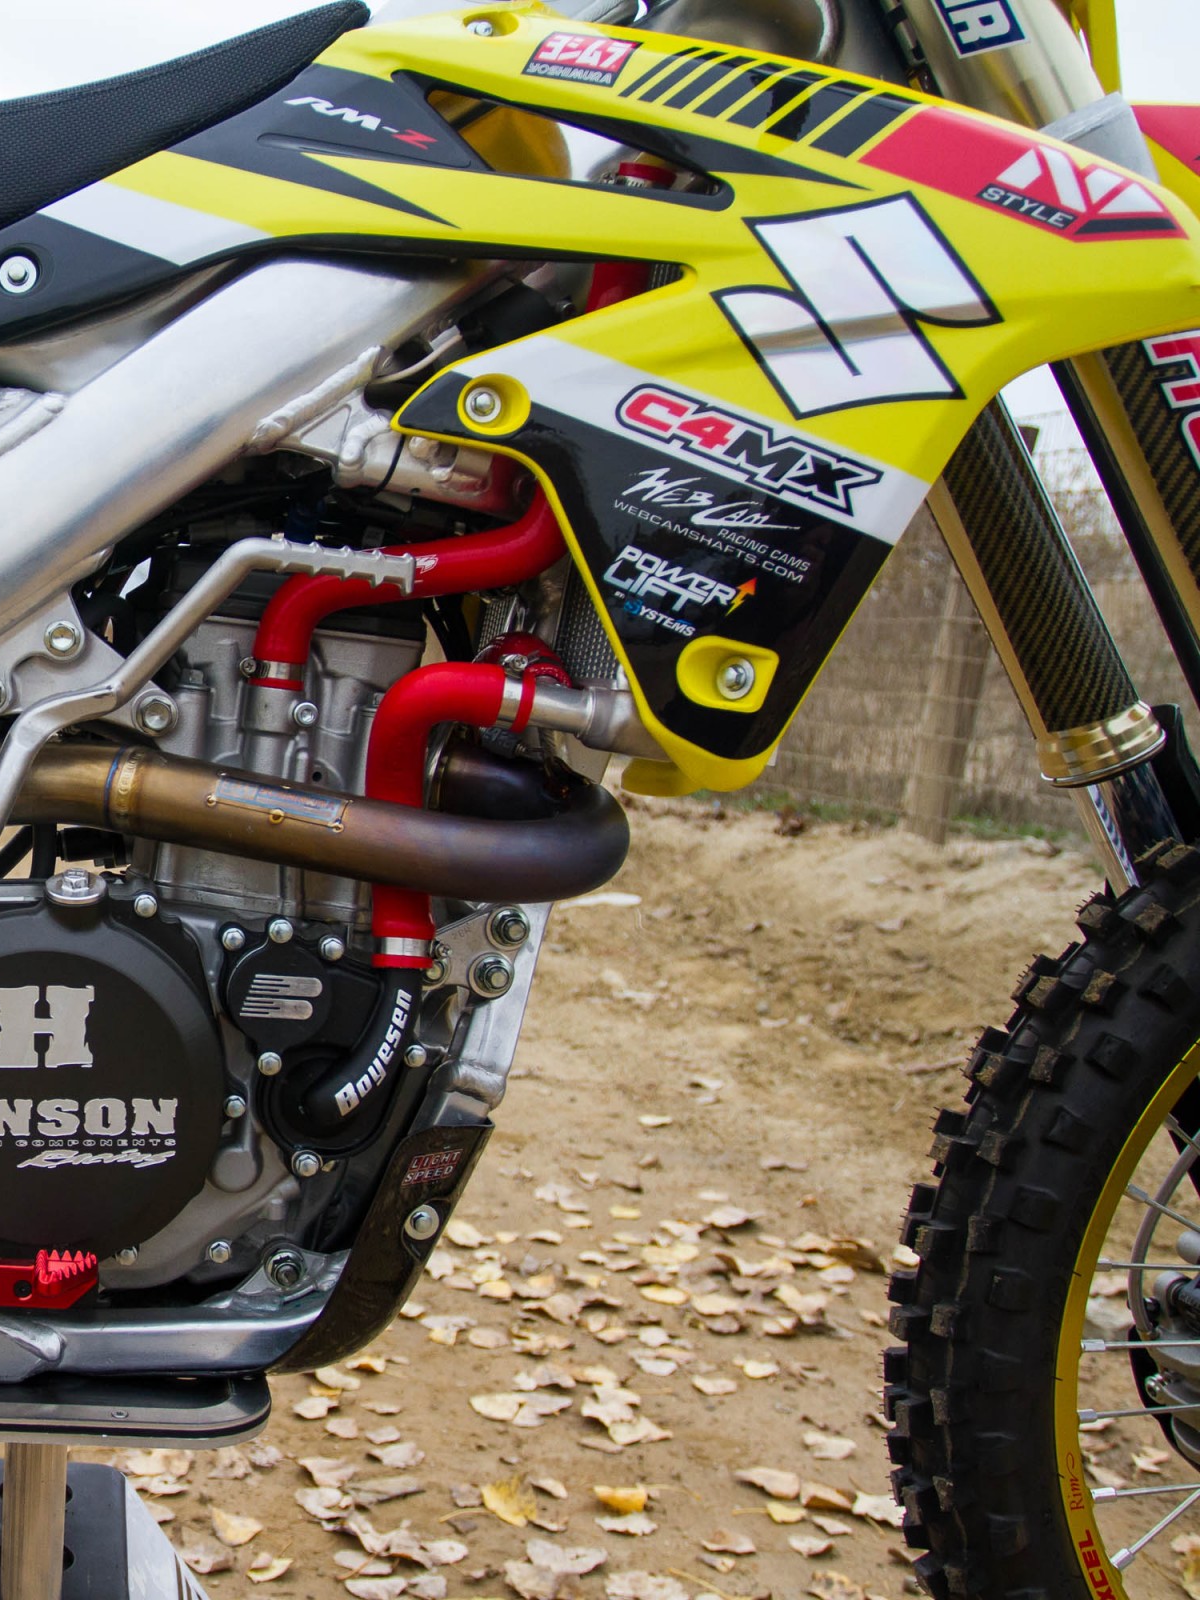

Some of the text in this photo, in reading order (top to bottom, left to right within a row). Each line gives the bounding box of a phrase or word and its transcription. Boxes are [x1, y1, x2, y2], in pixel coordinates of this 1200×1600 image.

[526, 62, 613, 84] YOSHIMURA
[283, 96, 438, 150] RM-Z
[982, 186, 1074, 228] STYLE
[621, 389, 874, 508] C4MX
[614, 498, 805, 584] WEBCAMSHAFTS.COM
[717, 527, 812, 572] RACING CAMS
[603, 559, 703, 612] LIFT
[615, 544, 738, 606] POWER
[623, 599, 697, 638] SYSTEMS
[334, 988, 412, 1117] Boyesen
[15, 1139, 177, 1148] COMPONENTS
[411, 1151, 461, 1169] LIGHT
[404, 1164, 454, 1183] SPEED
[1065, 1451, 1085, 1511] Rim
